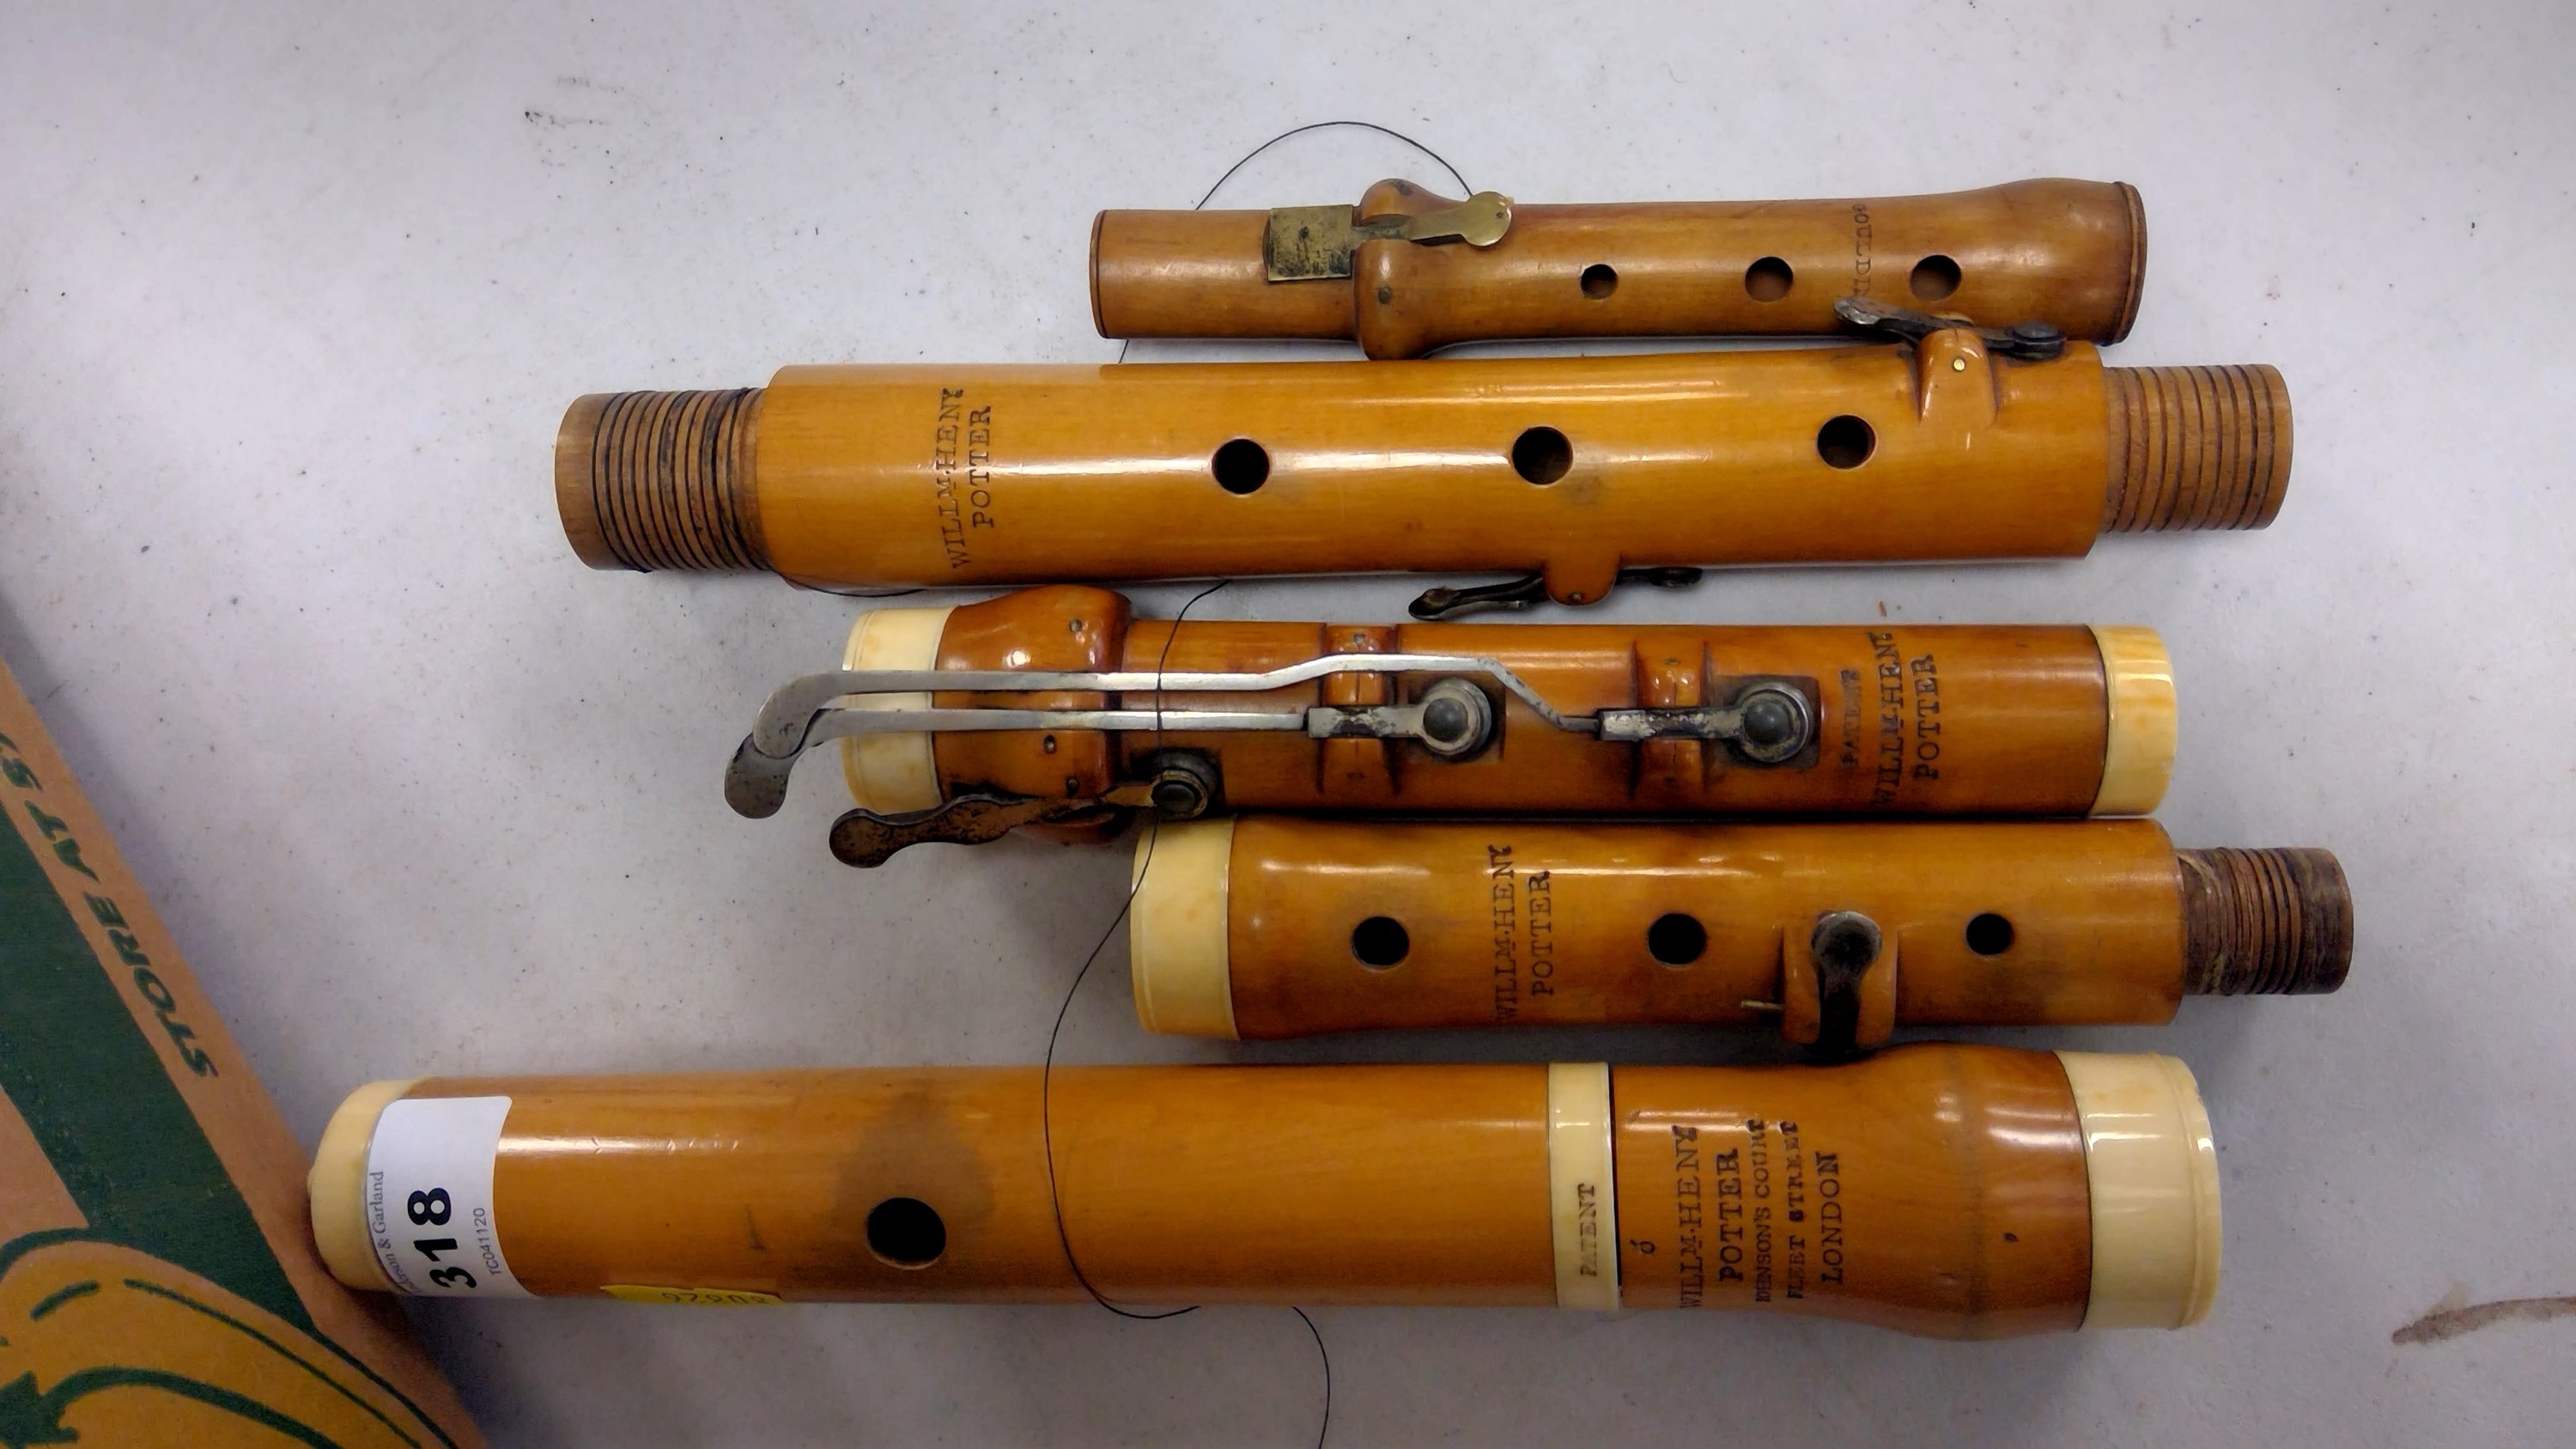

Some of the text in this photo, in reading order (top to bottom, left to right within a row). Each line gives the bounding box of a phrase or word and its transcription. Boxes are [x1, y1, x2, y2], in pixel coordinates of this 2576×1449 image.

[969, 405, 993, 528] POTTER
[1909, 653, 1941, 781] POTTER
[24, 800, 101, 884] AT
[84, 890, 220, 1079] STORE
[1528, 870, 1553, 996] POTTER
[369, 1172, 386, 1234] Garland
[1716, 1148, 1744, 1282] POTTER
[1747, 1119, 1771, 1200] COURT
[376, 1238, 392, 1250] &
[407, 1187, 477, 1288] 318
[473, 1208, 501, 1276] TC041120
[1814, 1150, 1844, 1285] LONDON
